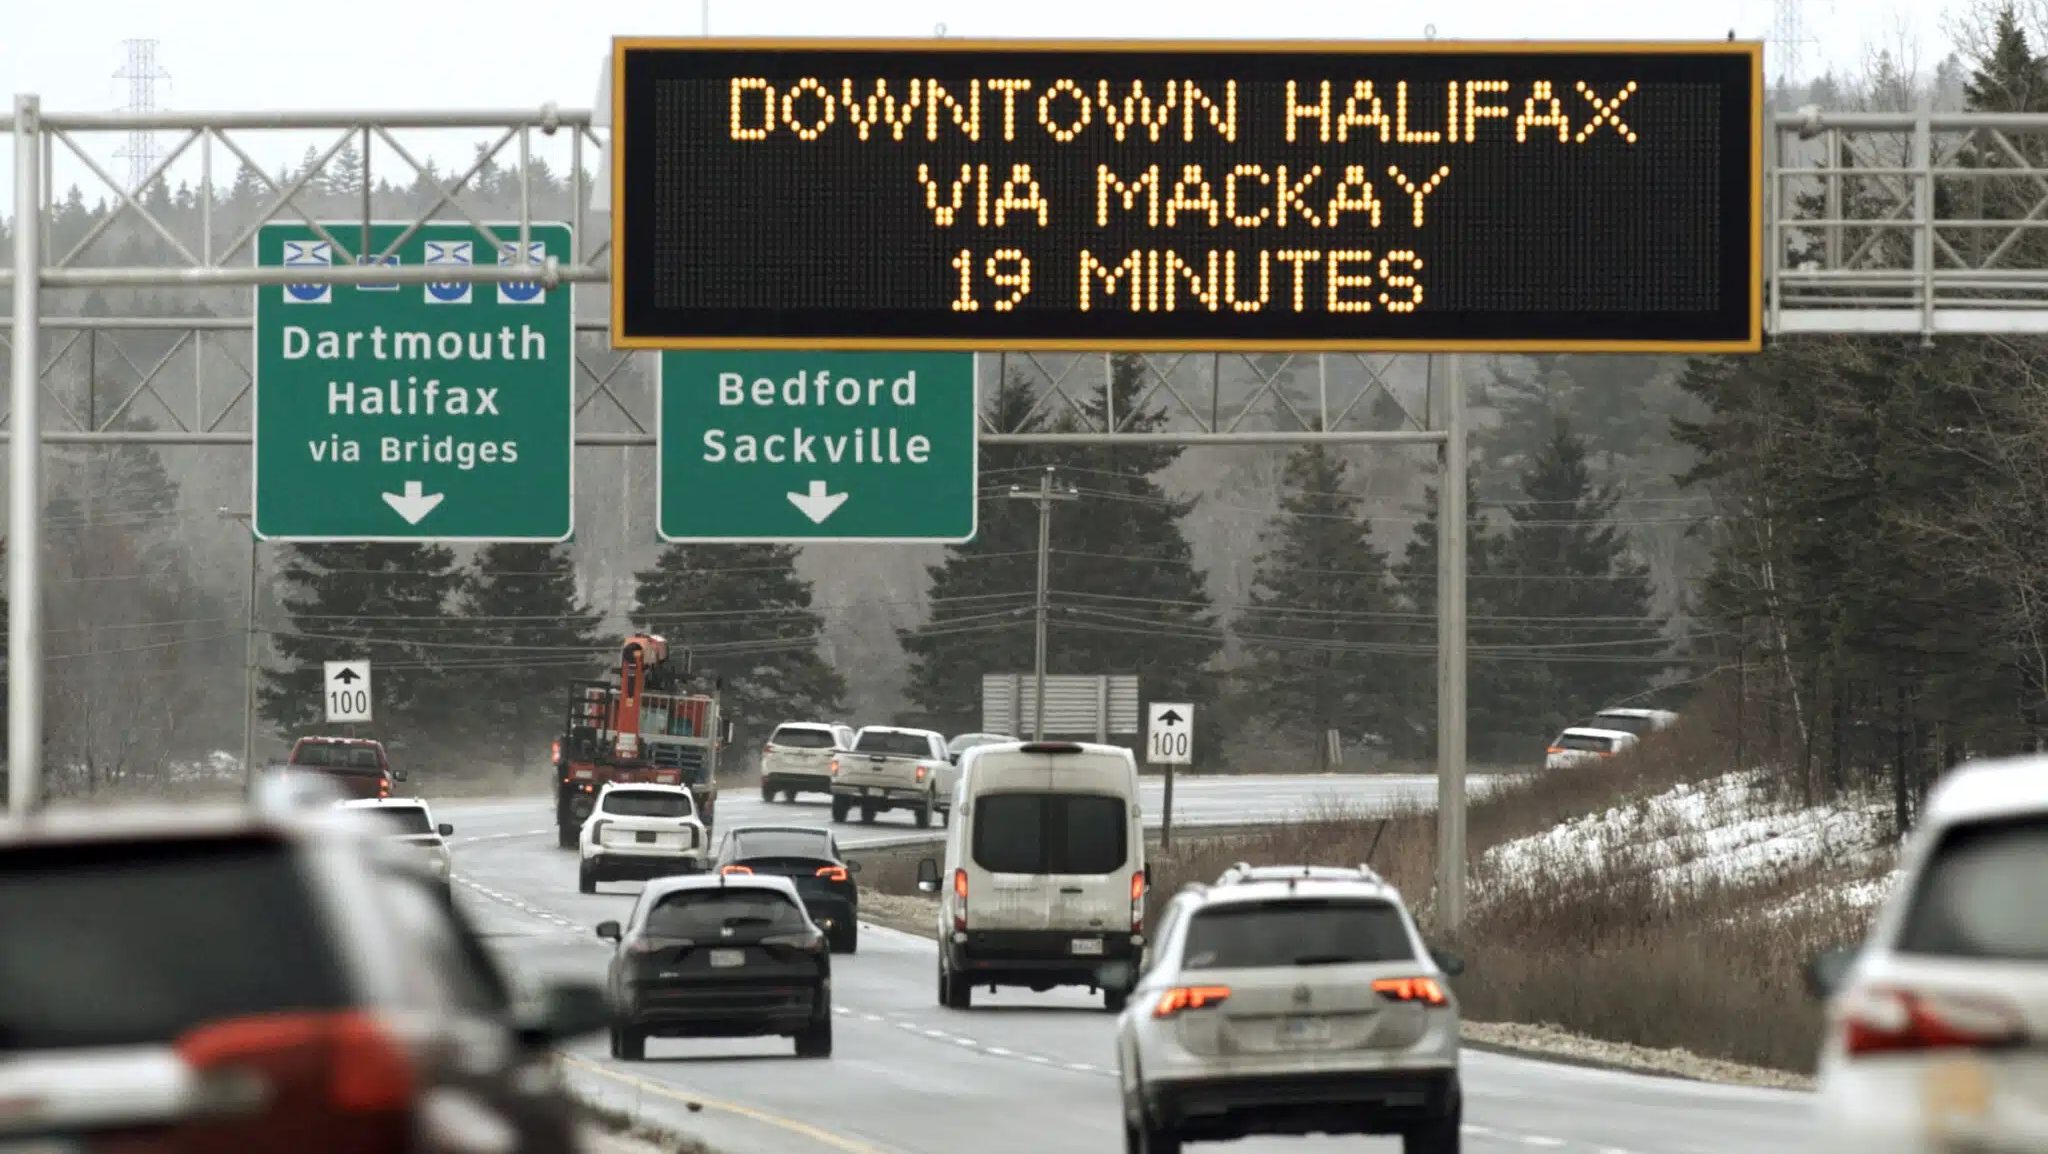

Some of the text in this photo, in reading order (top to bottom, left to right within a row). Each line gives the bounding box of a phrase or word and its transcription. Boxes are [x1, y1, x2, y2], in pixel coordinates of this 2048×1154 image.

[730, 77, 1636, 143] DOWNTOWN HALIFAX
[918, 164, 1449, 227] VIA MACKAY
[952, 249, 1423, 312] 19 MINUTES
[284, 325, 545, 360] Dartmouth
[329, 377, 498, 414] Halifax
[719, 371, 915, 405] Bedford
[309, 434, 517, 469] via Bridges
[704, 428, 930, 463] Sackville
[331, 691, 366, 713] 100
[1154, 733, 1187, 756] 100
